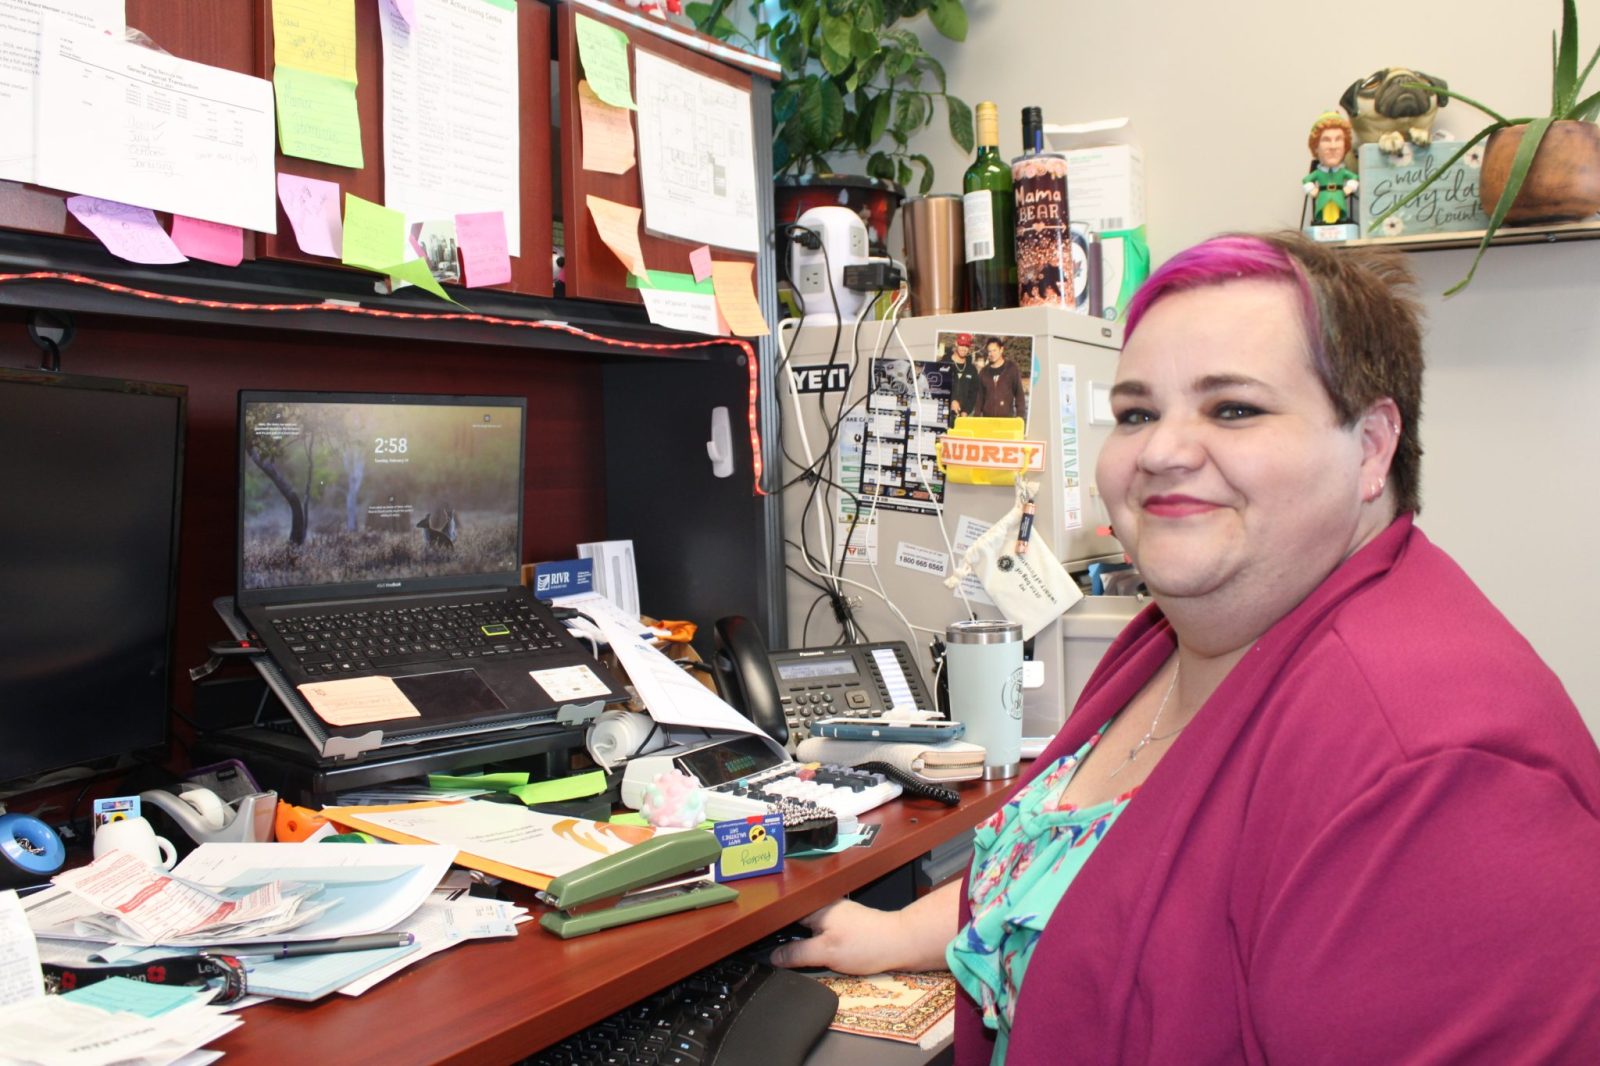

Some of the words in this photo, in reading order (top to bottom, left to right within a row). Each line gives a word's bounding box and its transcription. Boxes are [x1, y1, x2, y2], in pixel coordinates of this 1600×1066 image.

[1445, 168, 1480, 202] da
[1015, 188, 1062, 205] Mama
[1018, 204, 1060, 222] BEAR
[793, 368, 847, 390] YETI
[374, 437, 408, 454] 2:58
[941, 441, 1039, 465] AUDREY
[903, 556, 915, 565] 800
[915, 558, 928, 568] 665
[551, 571, 570, 585] RIVR
